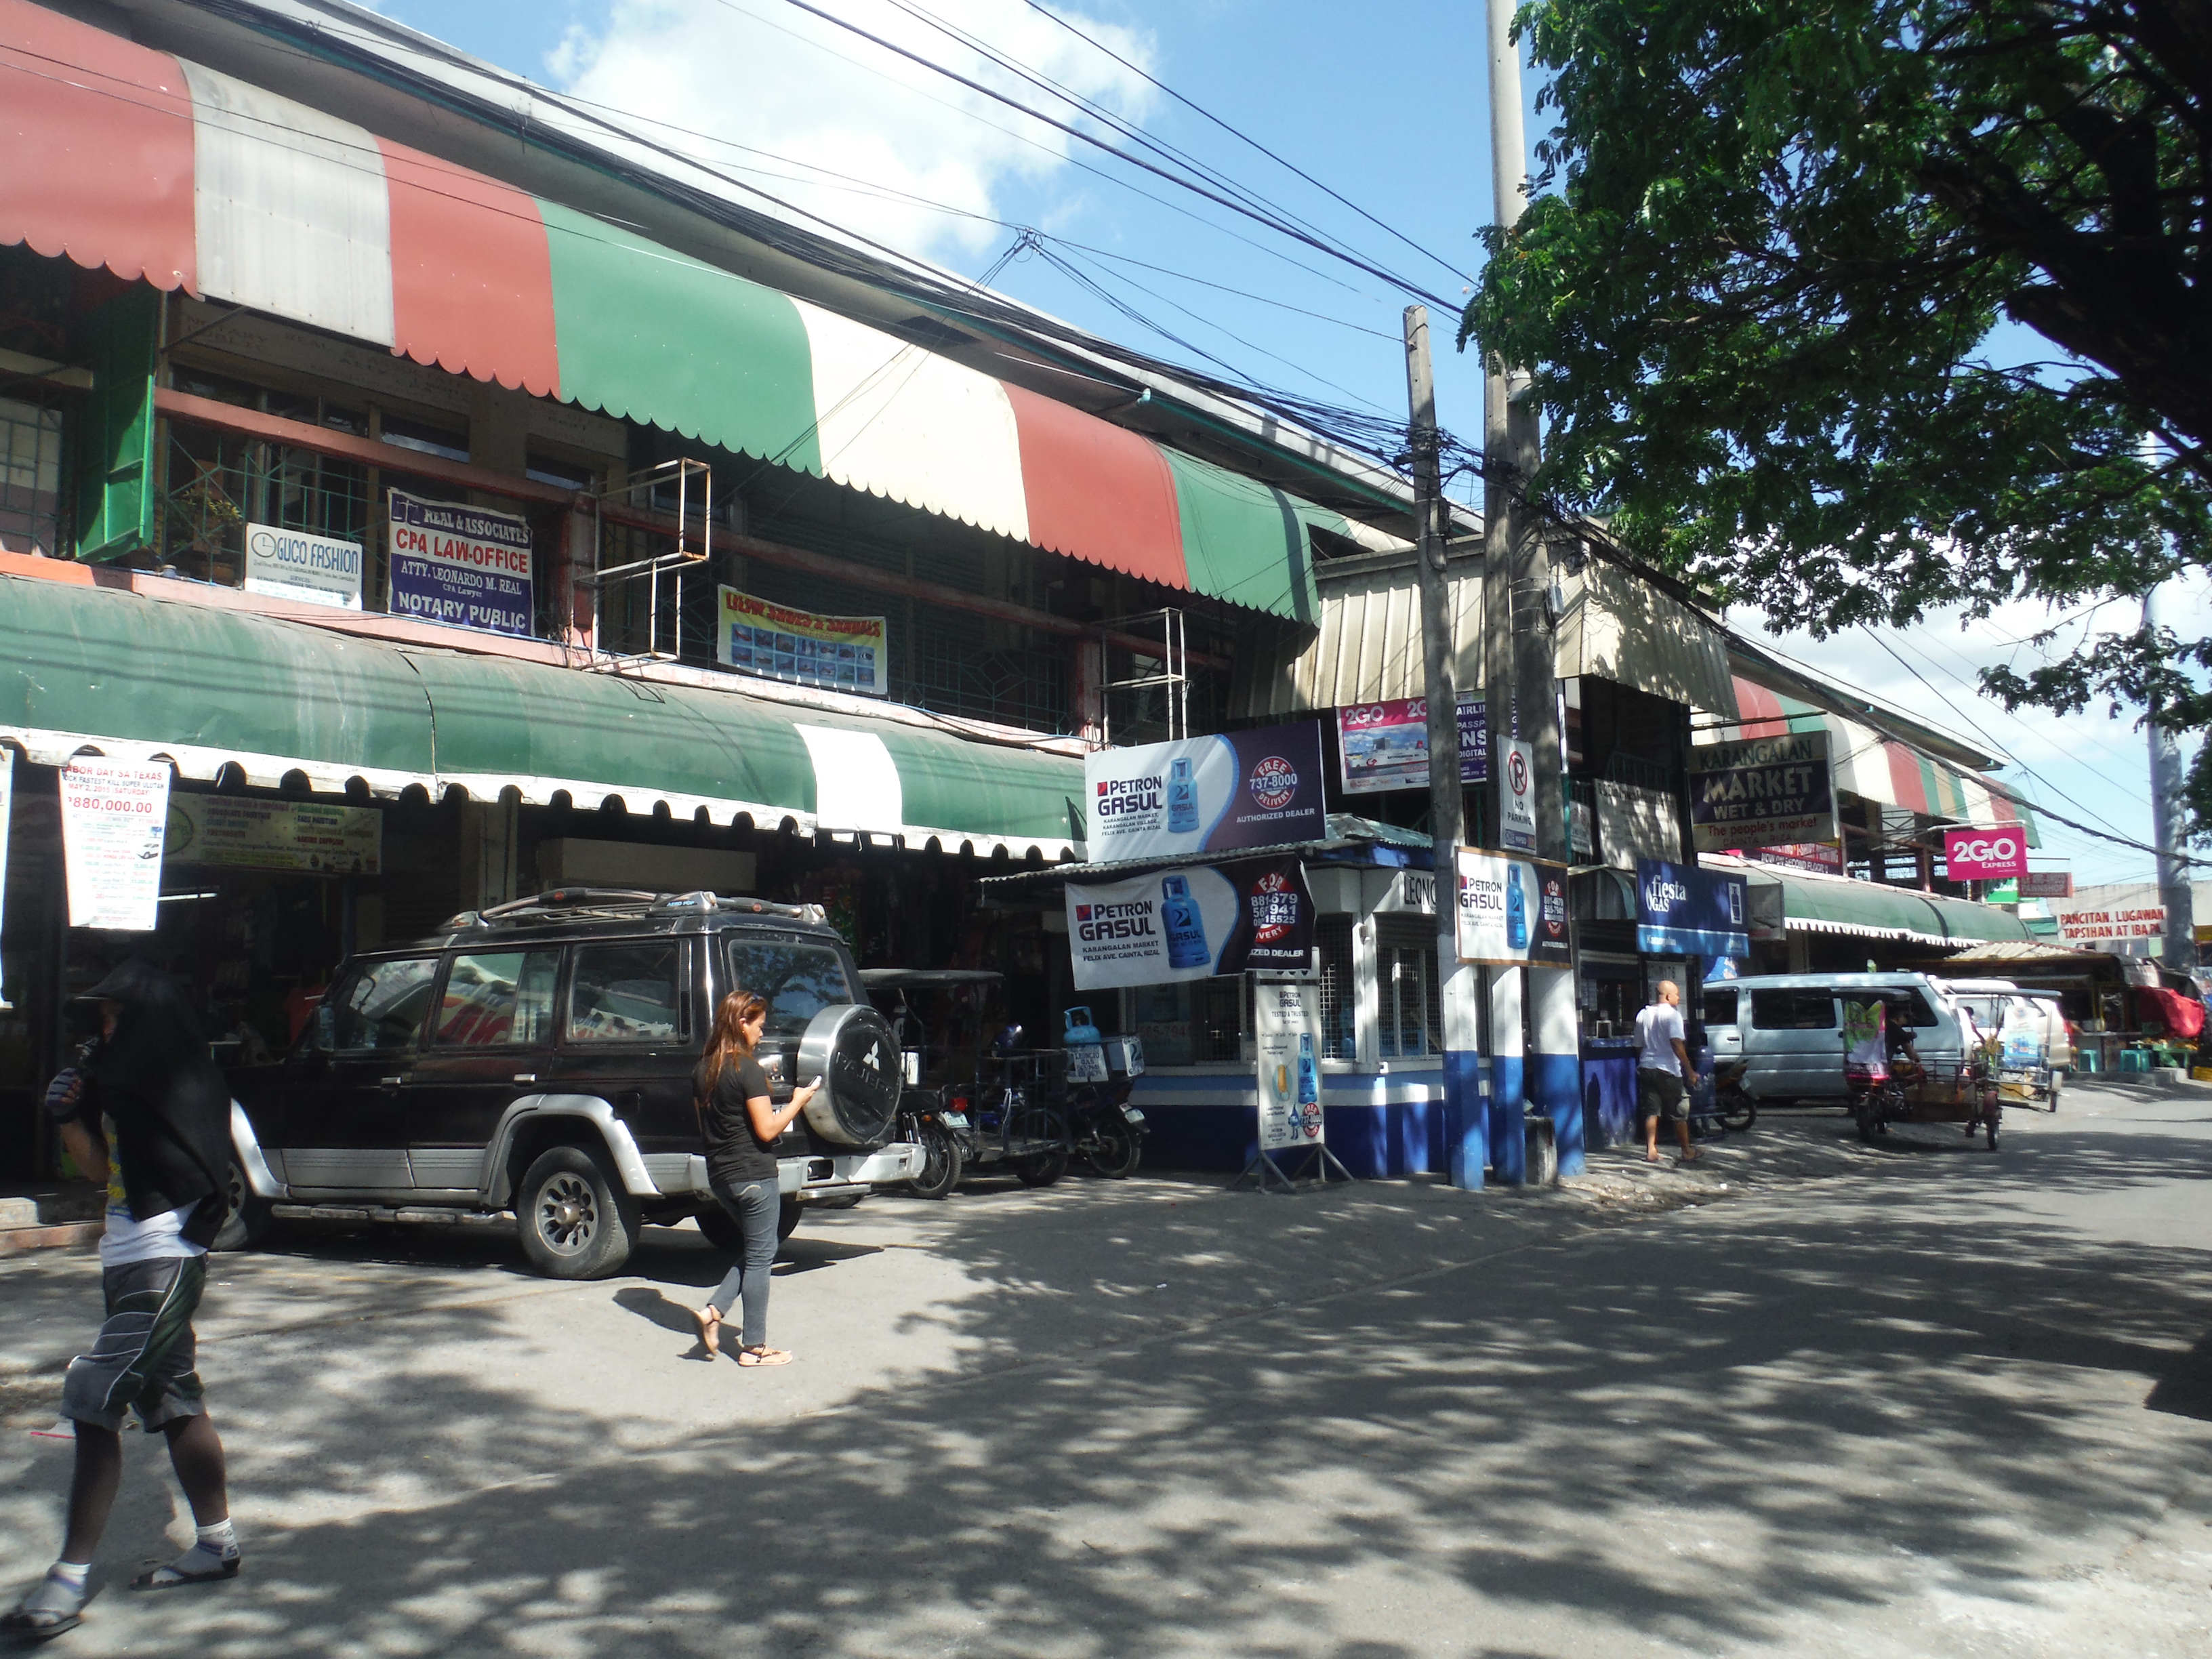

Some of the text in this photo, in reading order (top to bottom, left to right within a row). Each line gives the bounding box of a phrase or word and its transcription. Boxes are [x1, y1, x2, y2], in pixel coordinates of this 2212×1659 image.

[424, 509, 529, 544] REAL & ASSOCIATES
[276, 537, 307, 565] GUCO
[310, 543, 358, 575] FASHION
[396, 529, 528, 573] CPA LAW-OFFICE
[401, 560, 522, 595] ATTY. LEONARDO M. REAL
[443, 583, 482, 598] CPA Lawyer
[398, 591, 526, 629] NOTARY PUBLIC
[1346, 705, 1384, 725] 2GO
[96, 768, 115, 777] DAY
[118, 770, 130, 778] SA
[134, 771, 162, 780] TEXAS
[1258, 760, 1288, 777] FREE
[79, 777, 106, 785] FASTEST
[1110, 776, 1162, 796] PETRON
[1249, 773, 1298, 790] 737-8000
[1702, 766, 1813, 803] MARKET
[1098, 792, 1163, 817] GASUL
[1258, 790, 1290, 806] DELIVERY
[1515, 800, 1524, 811] NO
[1171, 802, 1194, 812] GASUL
[1236, 808, 1315, 823] AUTHORIZED DEALER
[1713, 798, 1805, 820] WET & DRY
[1103, 815, 1136, 823] KARANGALAN
[1103, 822, 1136, 830] KARANGALAN
[1507, 812, 1532, 825] PARKING
[1707, 817, 1818, 836] The people's market
[1953, 838, 2016, 862] 2GO
[1761, 853, 1775, 863] NOW
[1785, 858, 1806, 869] SECOND
[1807, 862, 1824, 873] FLOOR
[1258, 873, 1284, 891] FOR
[1469, 878, 1502, 893] PETRON
[1652, 874, 1686, 901] fiesta
[1094, 900, 1152, 920] PETRON
[1460, 893, 1502, 910] GASUL
[1652, 897, 1669, 912] GAS
[2116, 909, 2164, 922] LUGAWAN
[1079, 917, 1156, 941] GASUL
[2064, 926, 2112, 939] TAPSIHAN
[2116, 925, 2128, 936] AT
[1082, 943, 1131, 953] KARANGALAN
[1279, 999, 1301, 1007] GASUL
[836, 1052, 893, 1099] PAJERO
